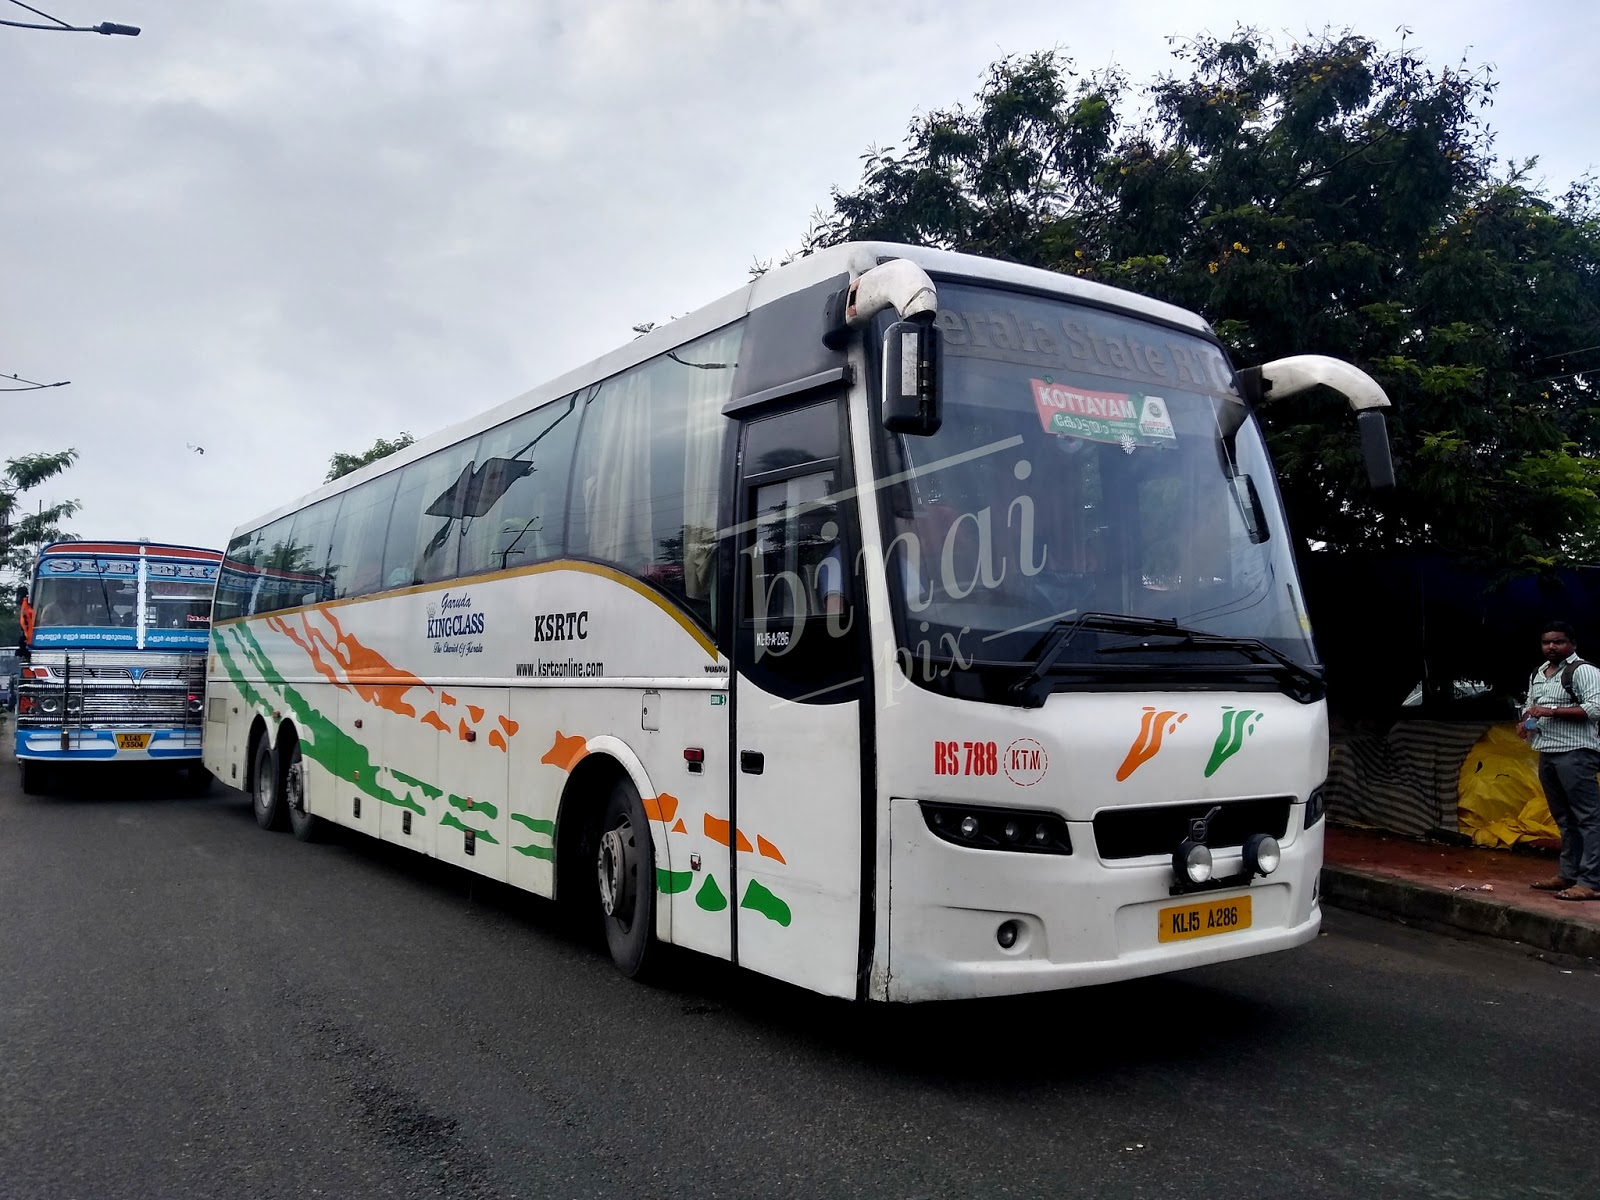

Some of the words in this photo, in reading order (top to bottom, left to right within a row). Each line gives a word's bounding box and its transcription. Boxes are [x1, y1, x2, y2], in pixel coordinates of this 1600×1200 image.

[936, 308, 1059, 356] erala
[1059, 317, 1169, 379] State
[1038, 386, 1138, 420] KOTTAYAM
[441, 592, 472, 616] Garuda
[427, 612, 485, 639] KINGCLASS
[533, 610, 589, 642] KSRTC
[515, 657, 604, 677] www.ksrtconline.com
[934, 741, 959, 776] RS
[963, 741, 998, 777] 788
[1011, 749, 1041, 770] KTM
